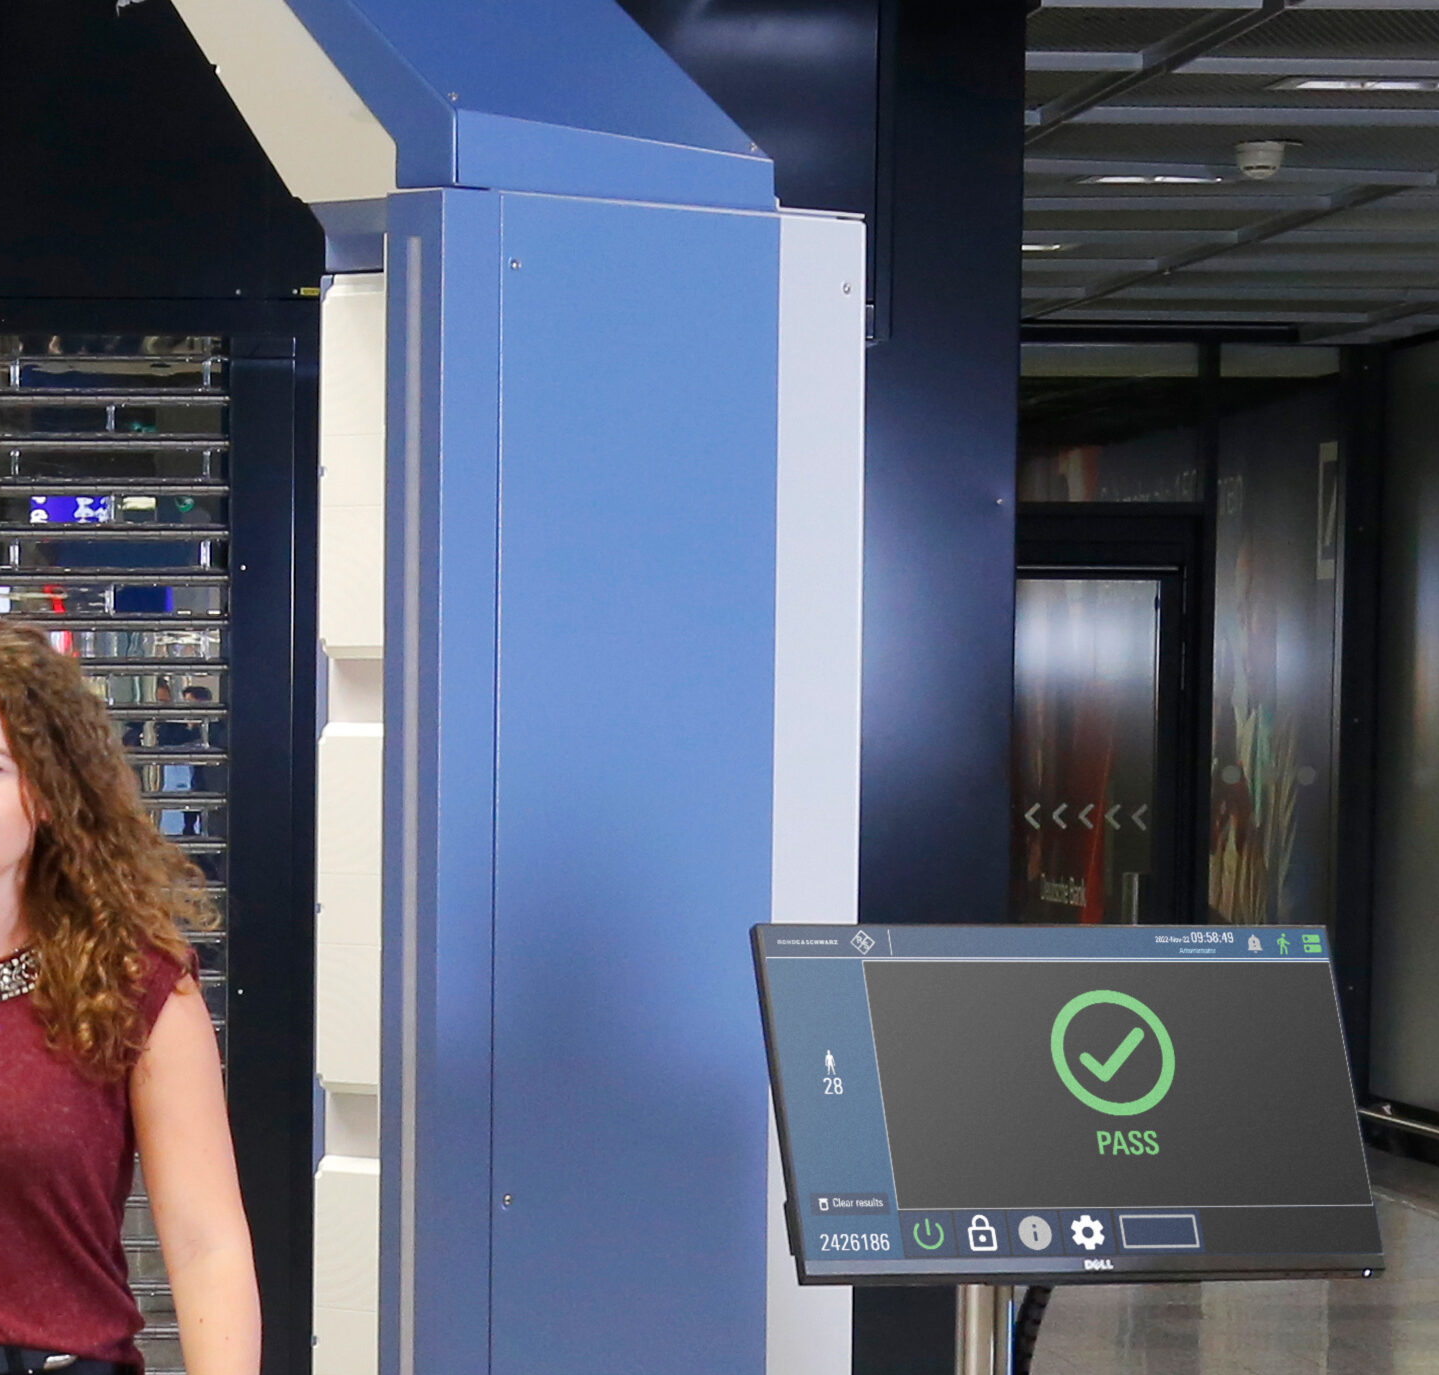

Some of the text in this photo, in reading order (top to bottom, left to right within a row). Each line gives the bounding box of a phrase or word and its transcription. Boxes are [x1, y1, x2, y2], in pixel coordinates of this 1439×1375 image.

[1190, 931, 1234, 944] 09:58:49
[823, 1077, 844, 1095] 28
[1096, 1130, 1160, 1155] PASS
[832, 1197, 884, 1208] Clear results
[820, 1233, 890, 1251] 2426186
[1084, 1259, 1114, 1271] DELL
